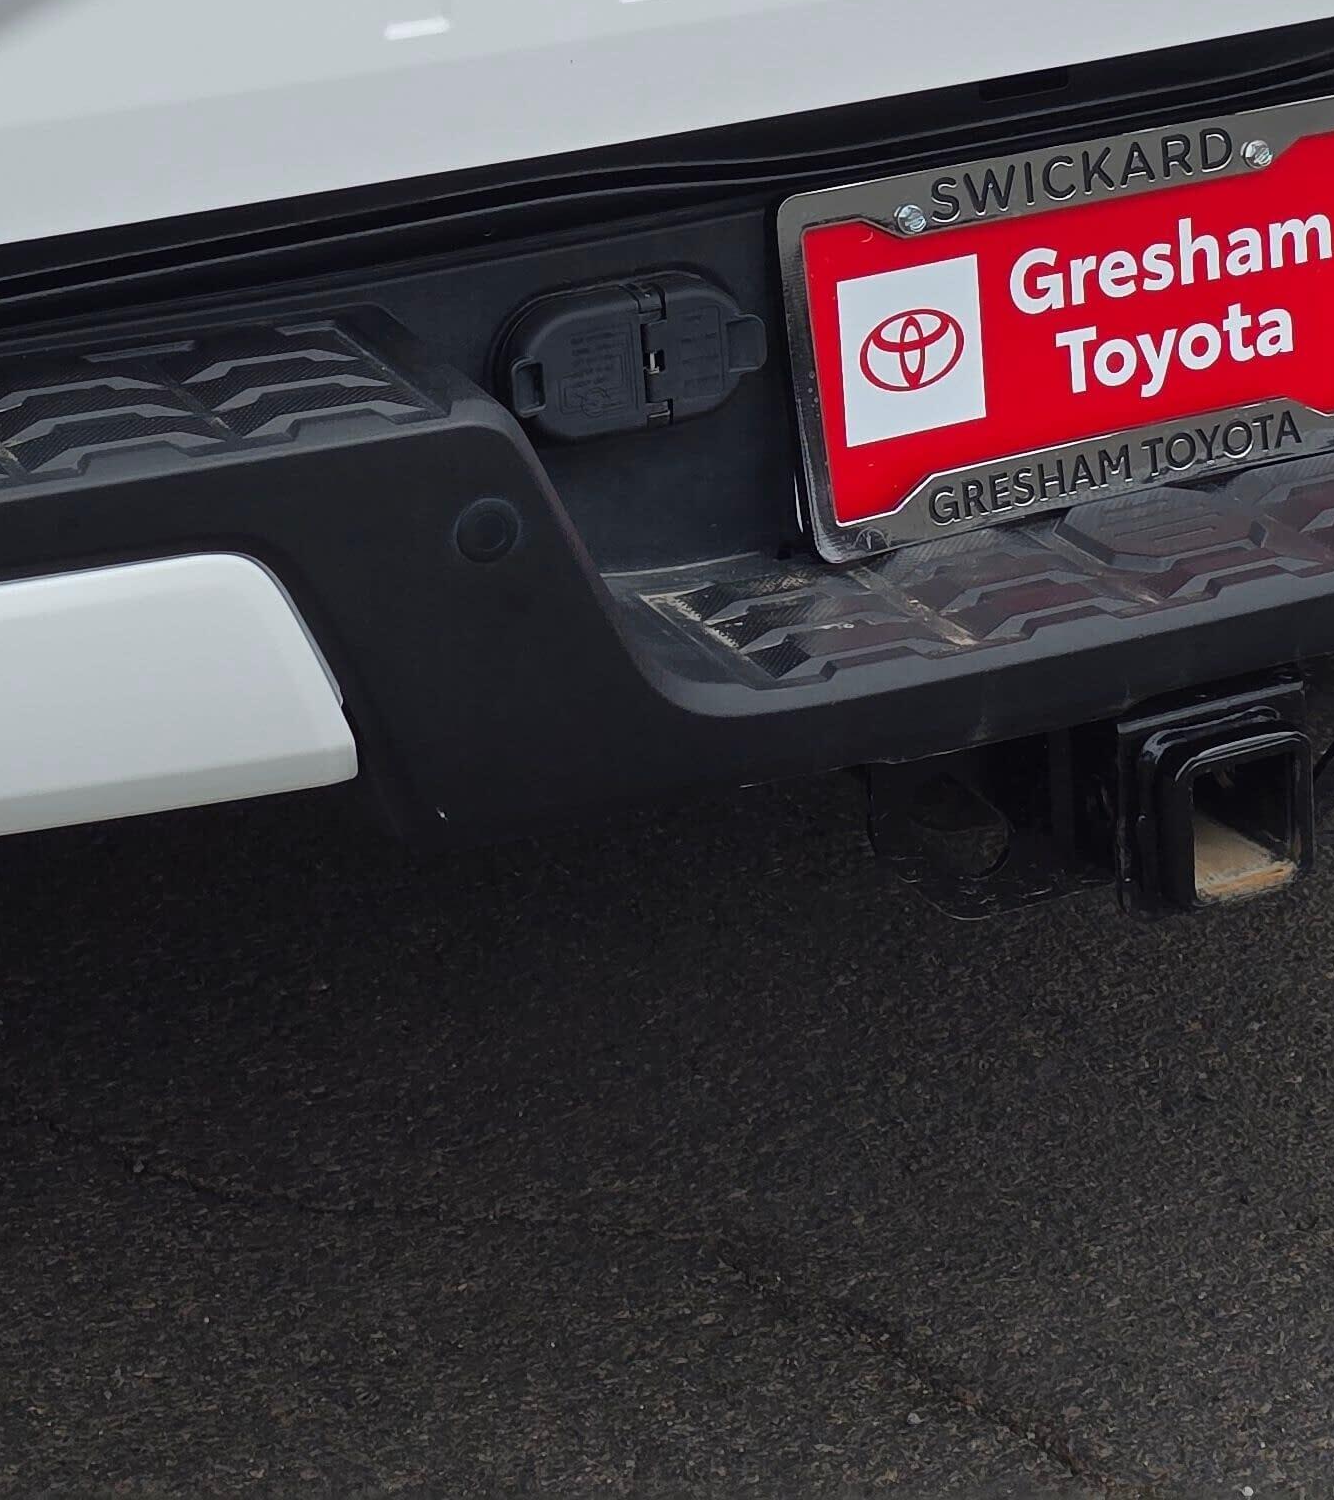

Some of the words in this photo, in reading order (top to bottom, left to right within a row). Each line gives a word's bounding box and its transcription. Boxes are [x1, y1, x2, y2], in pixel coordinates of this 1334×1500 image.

[929, 127, 1234, 225] SWICKARD
[1009, 213, 1333, 315] Gresham
[1055, 305, 1295, 398] Toyota
[928, 445, 1133, 527] GRESHAM
[1141, 411, 1303, 477] TOYOTA
